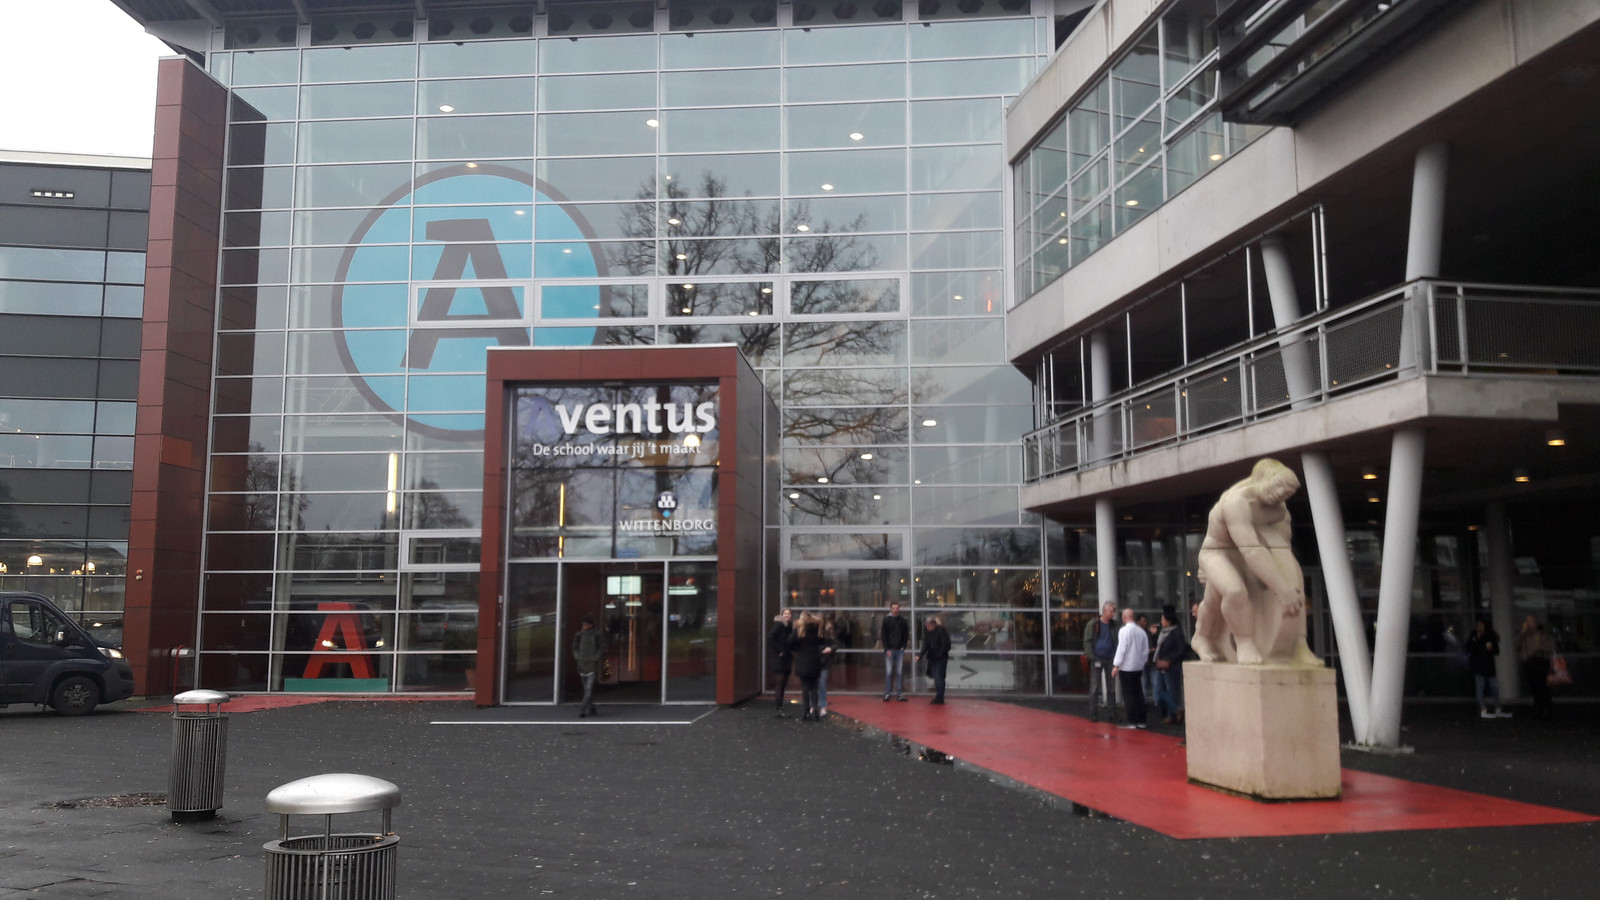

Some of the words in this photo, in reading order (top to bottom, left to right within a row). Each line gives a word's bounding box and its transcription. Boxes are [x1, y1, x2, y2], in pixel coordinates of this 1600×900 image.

[400, 218, 530, 370] A
[533, 442, 551, 456] De
[553, 442, 594, 456] school
[596, 445, 630, 456] waar
[631, 442, 646, 458] jij
[647, 441, 658, 455] 't
[659, 442, 701, 454] maakt
[619, 519, 714, 531] WITTENBORG
[302, 602, 375, 679] A
